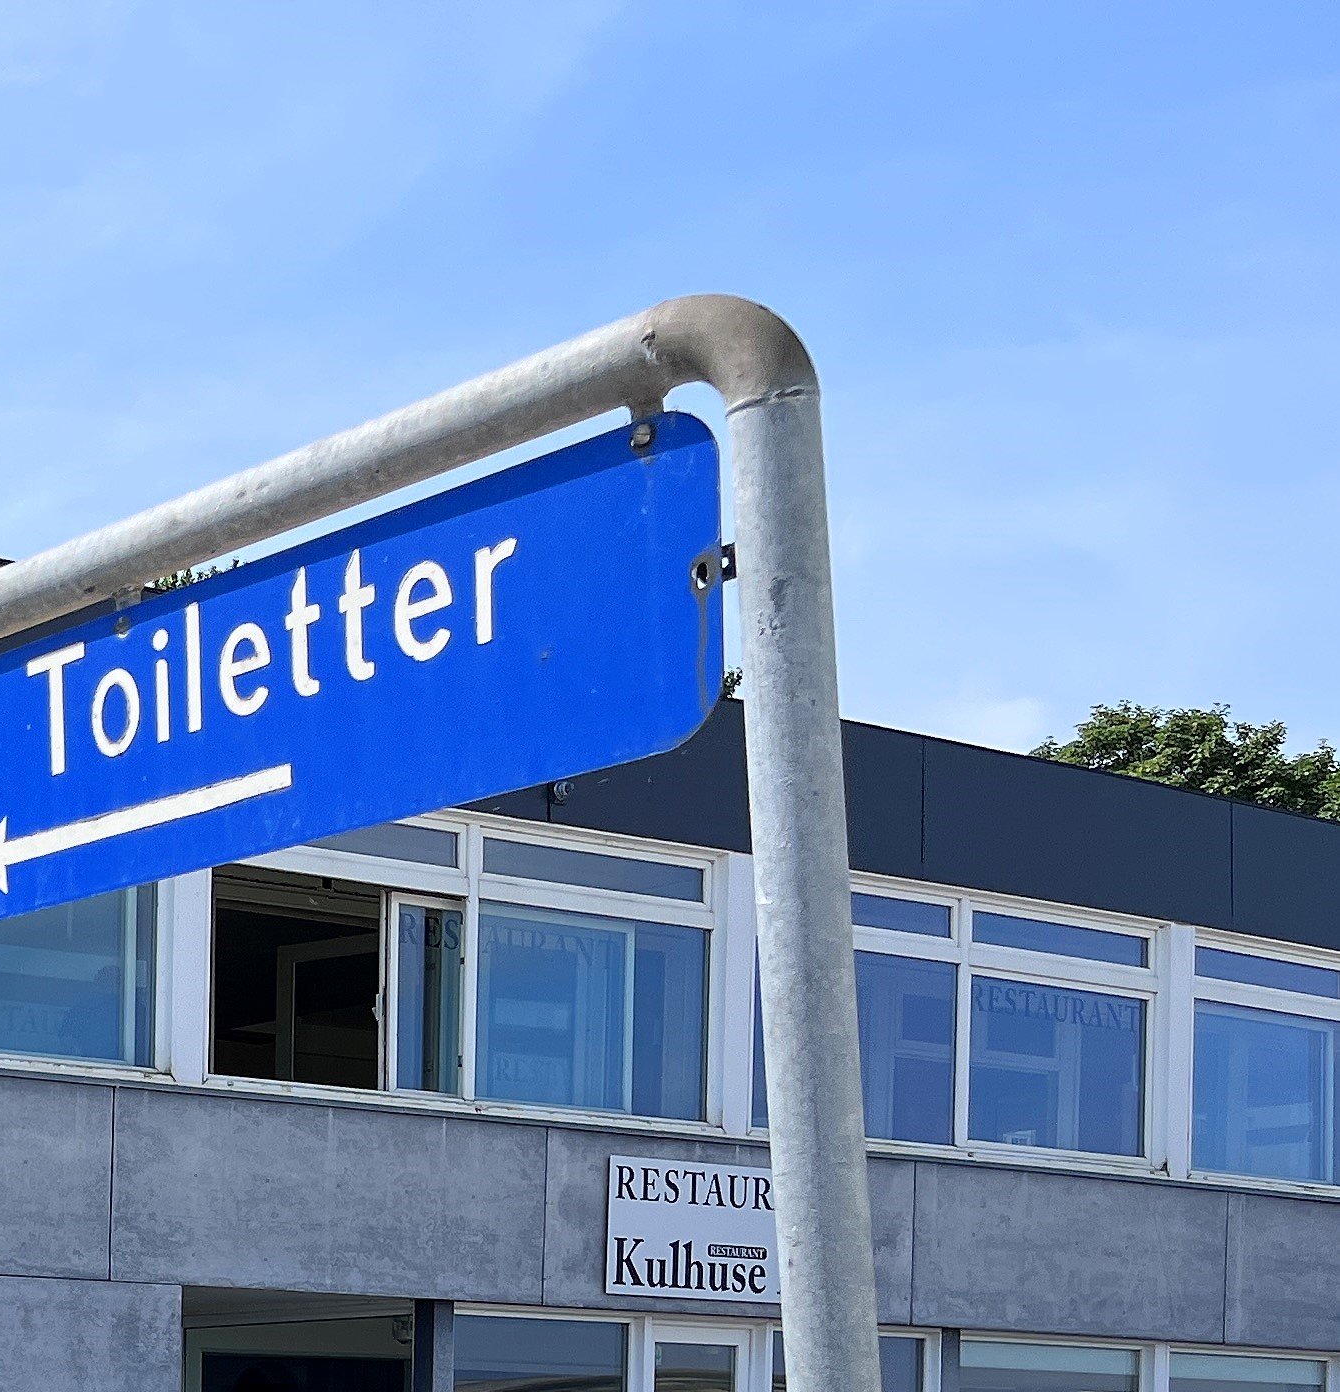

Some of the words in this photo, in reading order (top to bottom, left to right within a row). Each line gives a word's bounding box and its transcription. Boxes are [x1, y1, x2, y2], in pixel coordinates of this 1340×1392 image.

[25, 536, 518, 777] Toiletter
[972, 983, 1141, 1033] RESTAURANT
[615, 1164, 775, 1211] RESTAUR
[613, 1236, 766, 1294] Kulhuse
[709, 1245, 766, 1259] RESTAURANT
